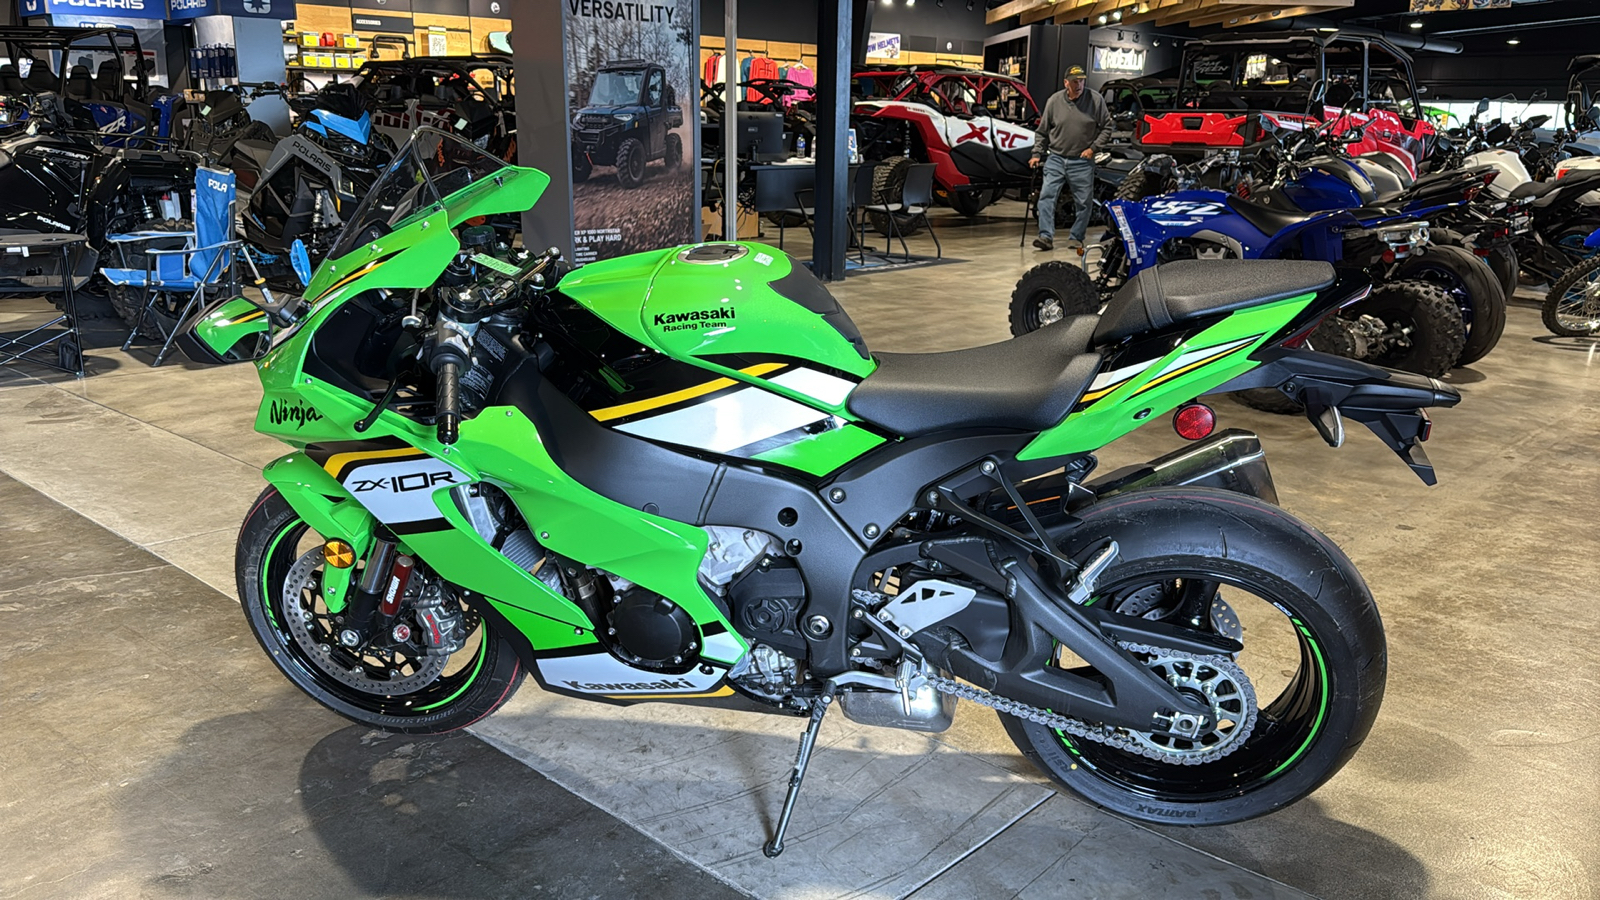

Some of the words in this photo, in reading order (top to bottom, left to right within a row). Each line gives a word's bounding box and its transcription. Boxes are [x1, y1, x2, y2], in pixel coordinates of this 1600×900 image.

[569, 0, 675, 24] VERSATILITY
[877, 36, 900, 50] HELMETS
[293, 141, 332, 173] POLARIS
[36, 215, 71, 231] POLARIS
[582, 235, 588, 243] &
[588, 234, 605, 243] PLAY
[605, 233, 622, 242] HARD
[654, 307, 736, 326] Kawasaki
[663, 322, 698, 333] Racing
[699, 321, 727, 329] Team
[270, 397, 324, 431] Ninja
[351, 471, 459, 493] ZX-10R
[561, 678, 698, 691] Kawasaki
[1135, 803, 1197, 818] BATTLAX
